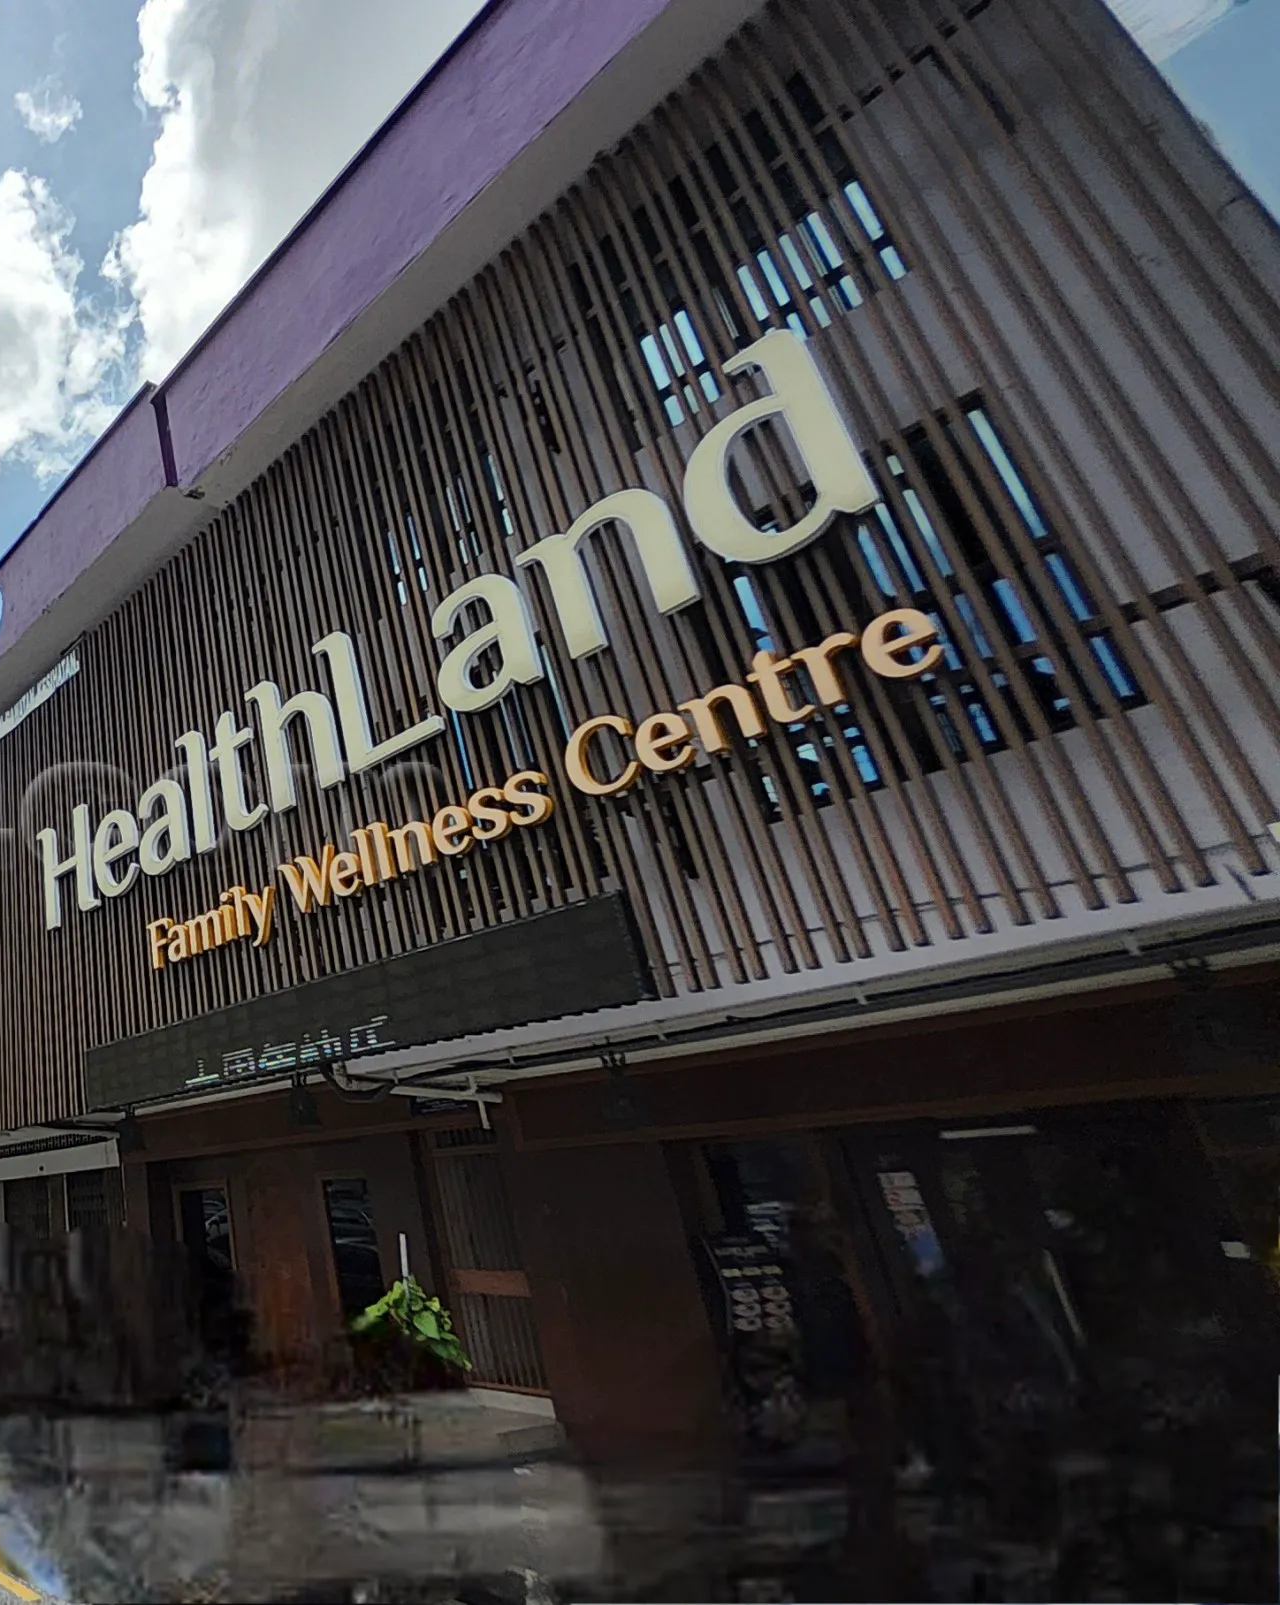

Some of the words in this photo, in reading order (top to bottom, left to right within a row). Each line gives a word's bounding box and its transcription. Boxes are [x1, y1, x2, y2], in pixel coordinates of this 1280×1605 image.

[36, 328, 882, 932] HealthLand
[146, 885, 277, 970] Family
[276, 768, 555, 915] Wellness
[564, 607, 946, 797] Centre
